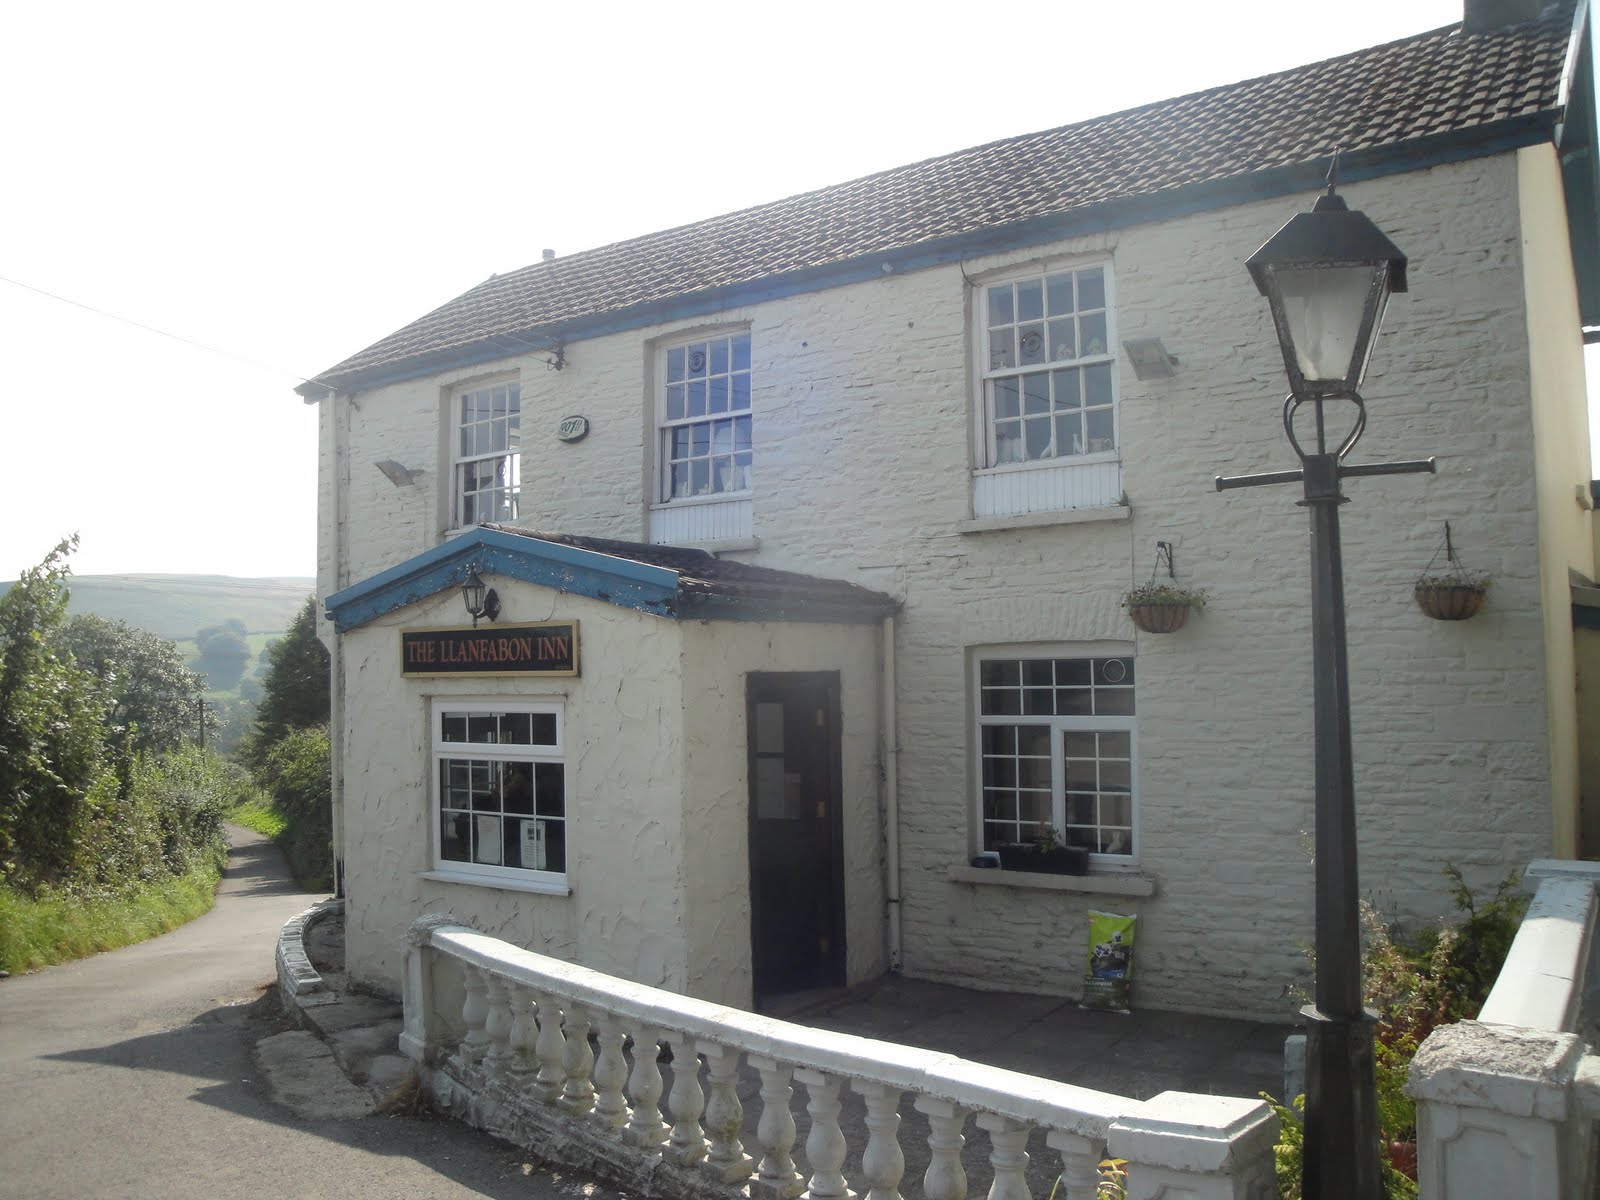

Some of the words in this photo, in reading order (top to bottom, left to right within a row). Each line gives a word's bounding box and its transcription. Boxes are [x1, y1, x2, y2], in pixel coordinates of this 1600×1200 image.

[407, 641, 436, 662] THE
[440, 638, 532, 662] LLANFABON
[537, 636, 570, 661] INN
